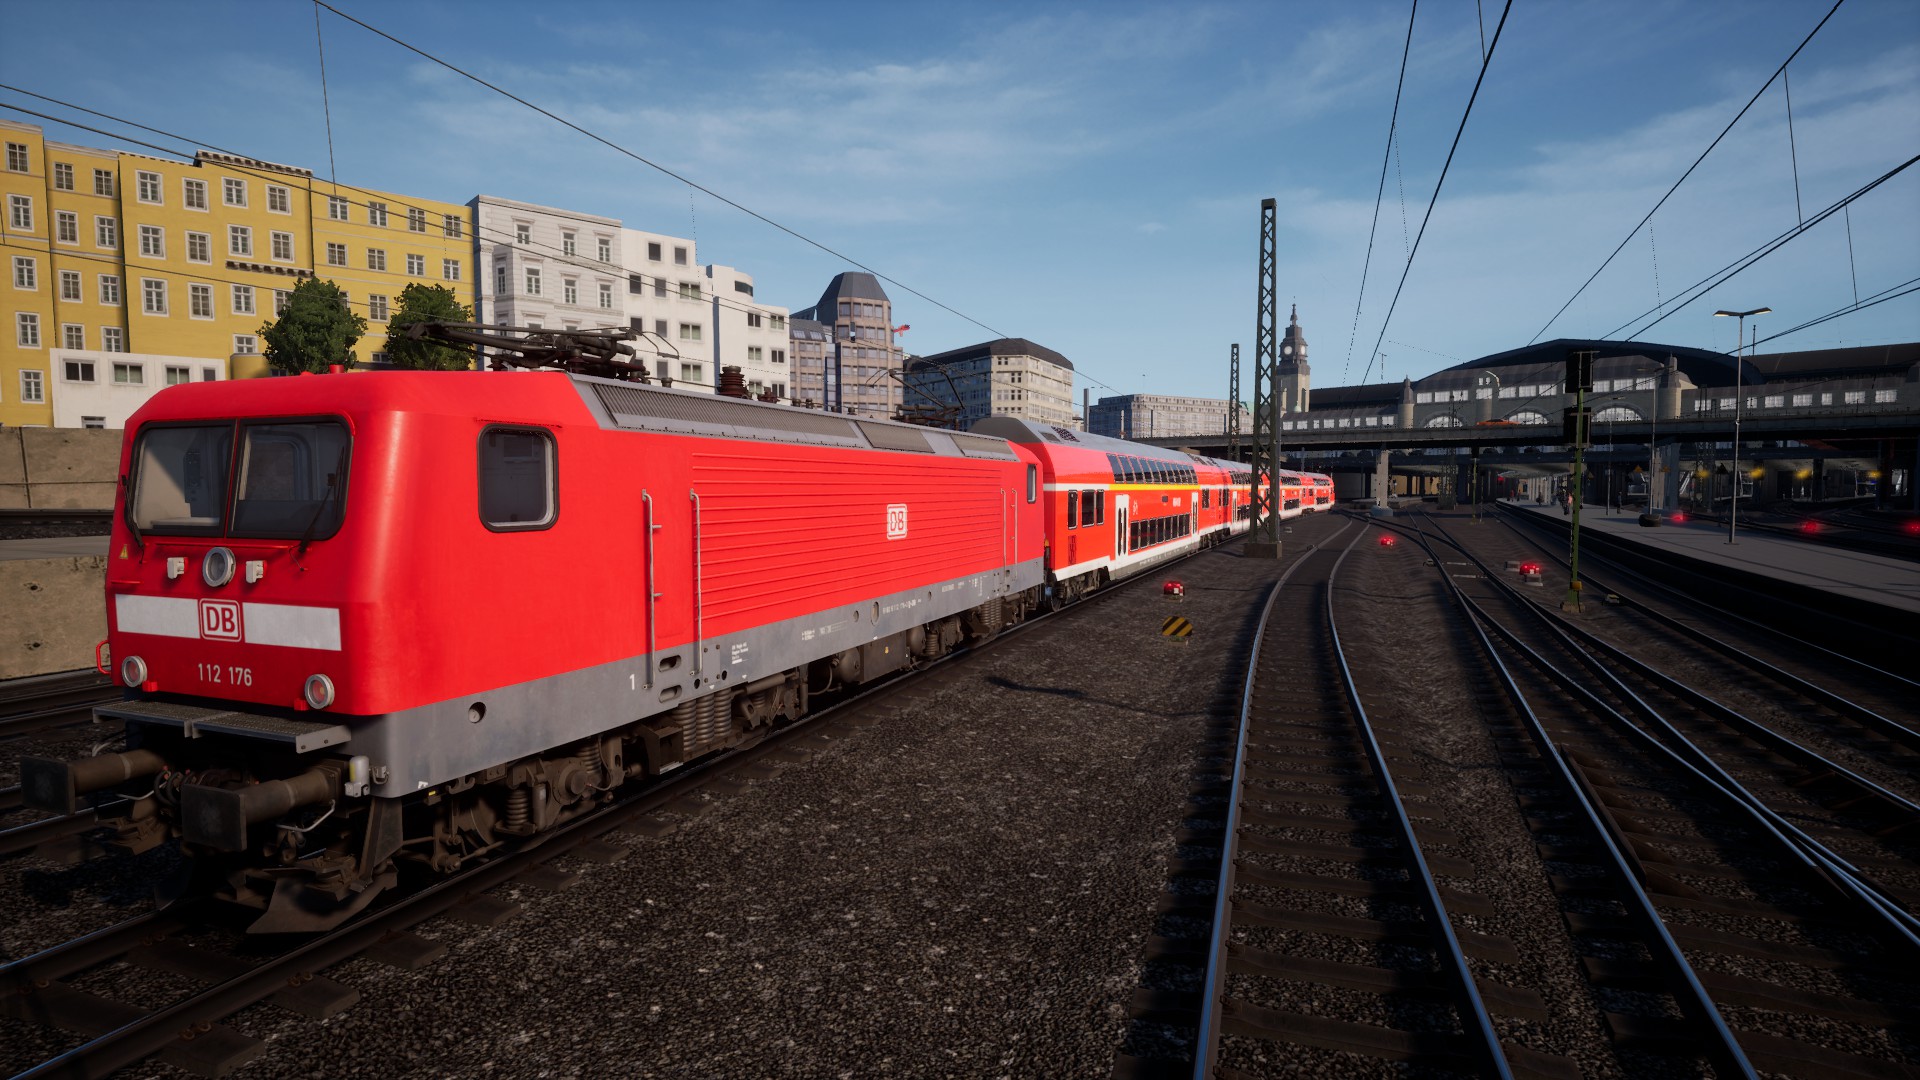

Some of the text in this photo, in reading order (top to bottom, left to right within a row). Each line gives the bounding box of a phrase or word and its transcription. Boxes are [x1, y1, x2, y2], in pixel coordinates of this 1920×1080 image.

[890, 510, 904, 532] DB
[205, 605, 236, 634] DB
[198, 663, 253, 687] 112 176
[629, 673, 636, 691] 1
